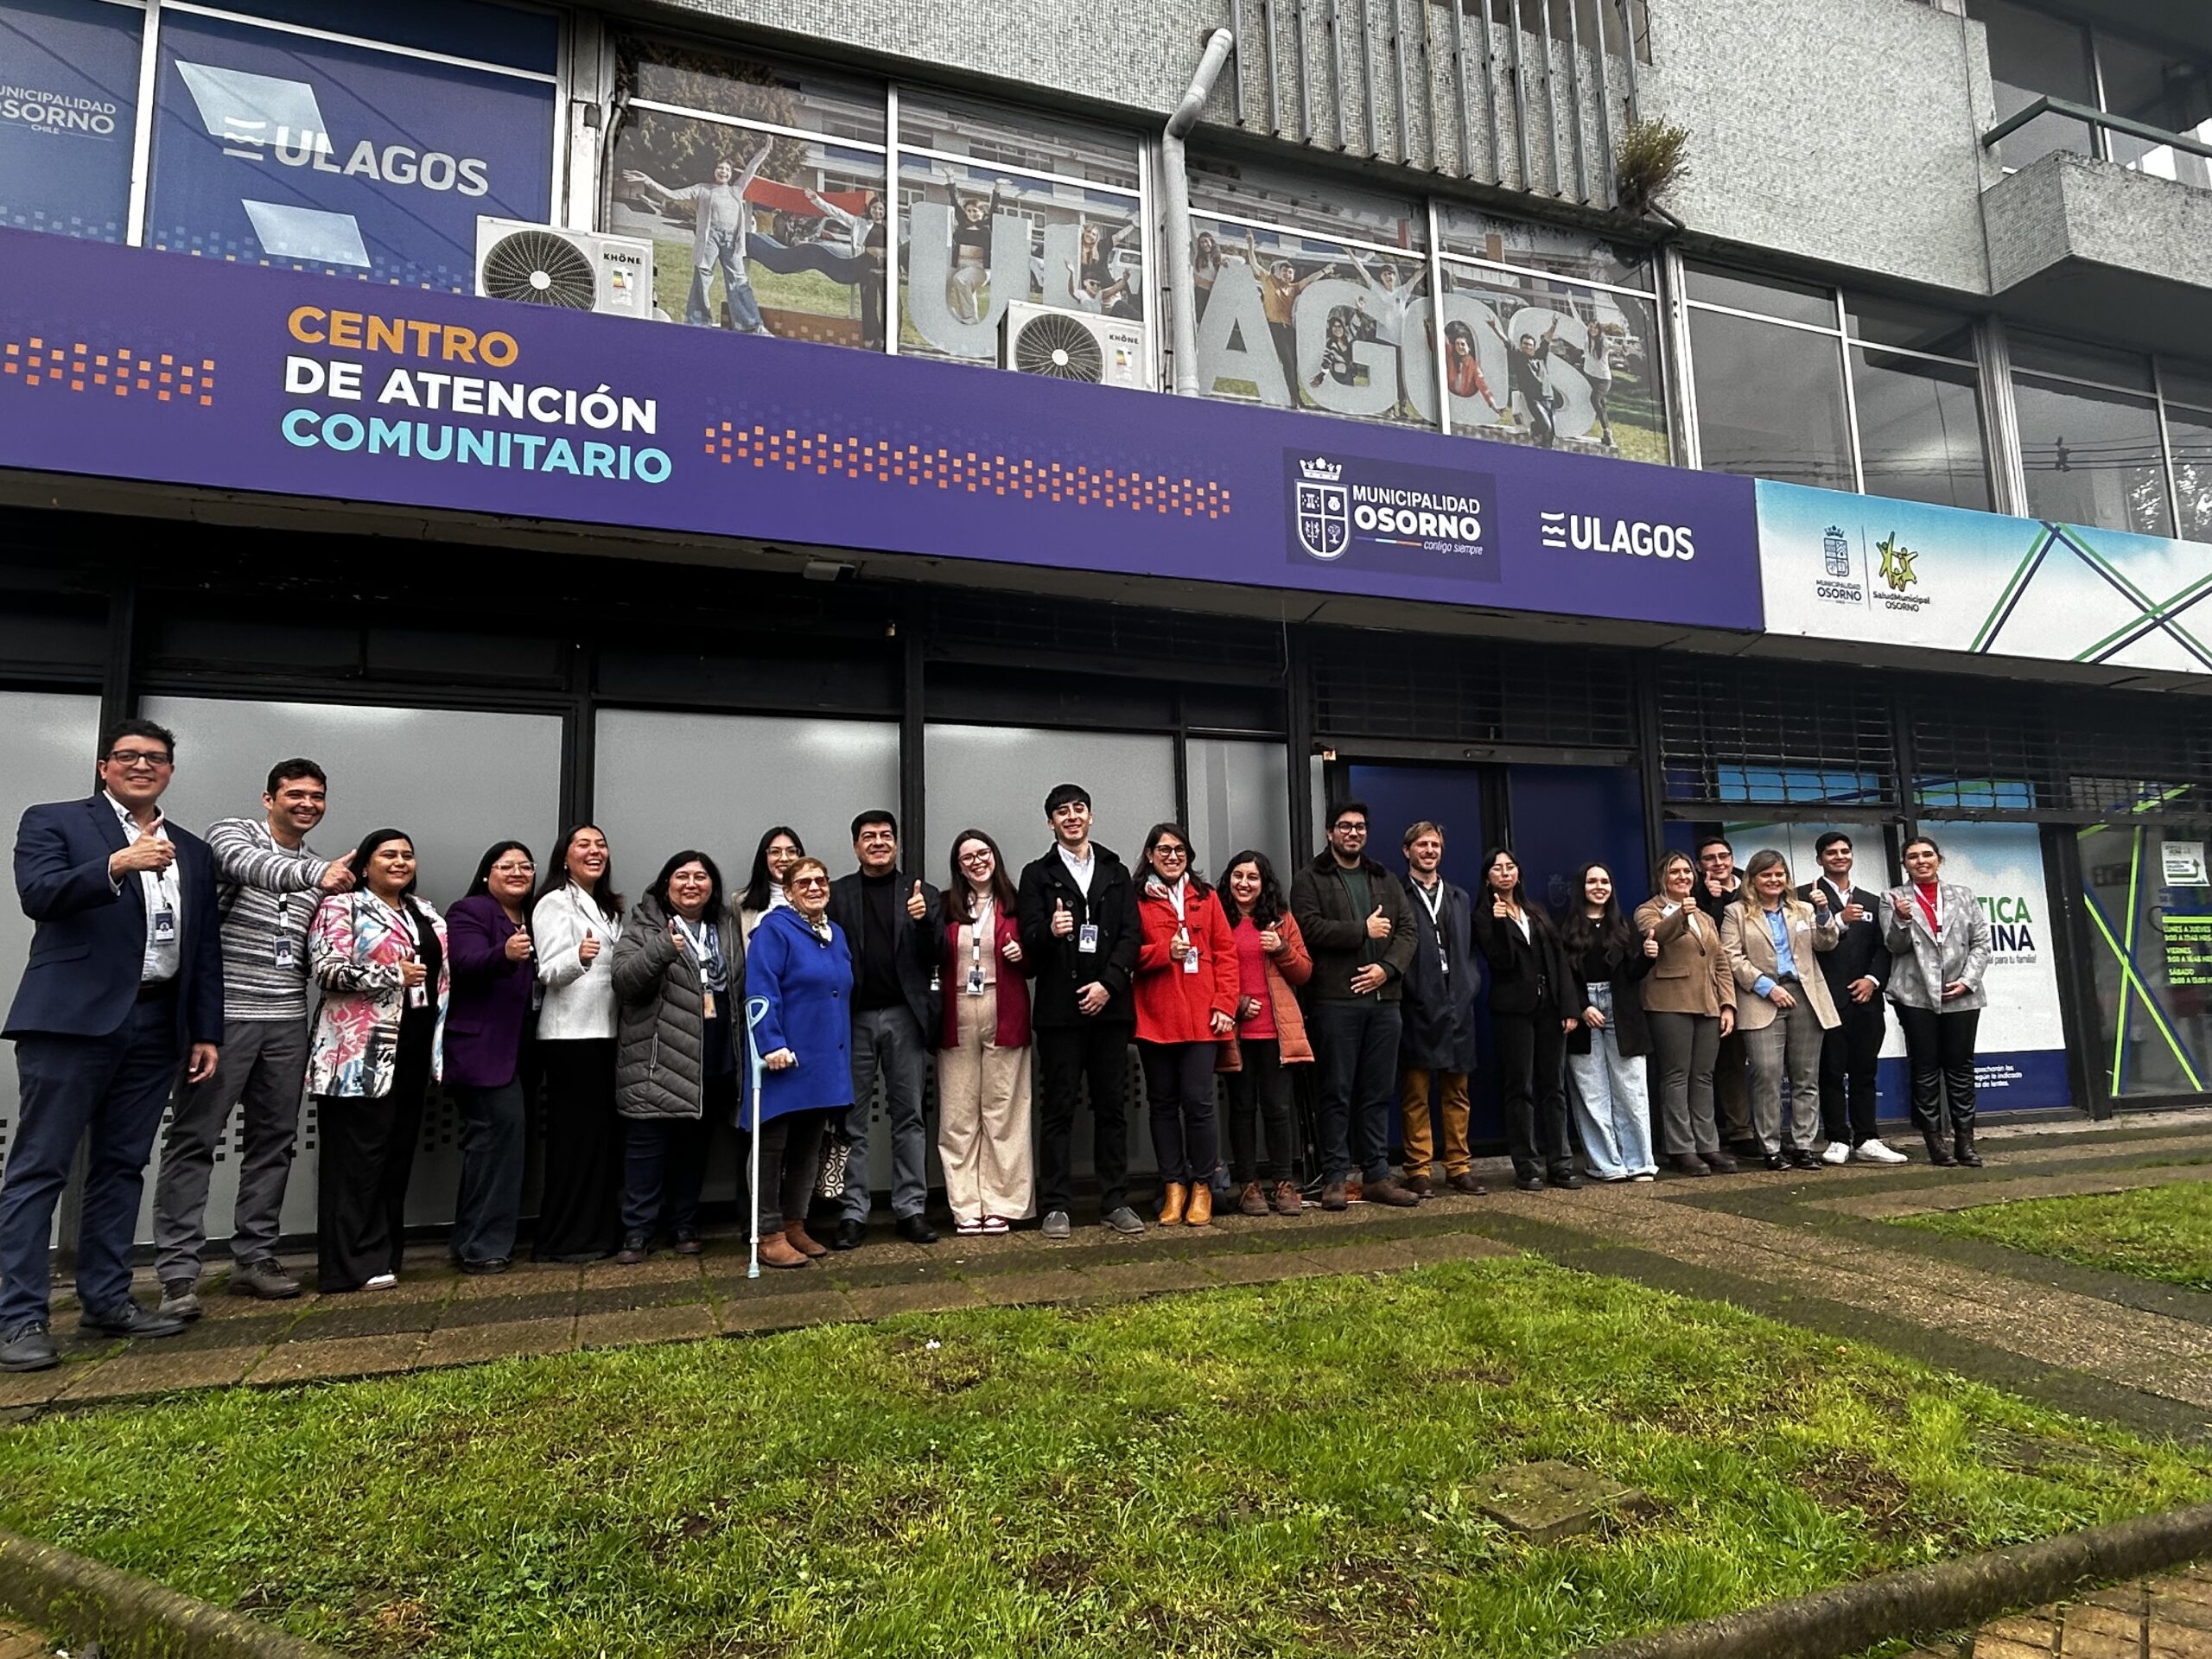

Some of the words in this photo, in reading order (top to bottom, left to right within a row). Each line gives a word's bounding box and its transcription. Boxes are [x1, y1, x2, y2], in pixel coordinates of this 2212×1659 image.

[0, 99, 115, 134] SORNO
[274, 125, 489, 197] ULAGOS
[288, 306, 518, 367] CENTRO
[285, 355, 363, 400] DE
[378, 368, 657, 435] ATENCIÓN
[282, 409, 672, 483] COMUNITARIO
[1352, 485, 1481, 514] MUNICIPALIDAD
[1354, 505, 1482, 541] OSORNO
[1570, 514, 1695, 561] ULAGOS
[1423, 541, 1452, 554] contigo
[1453, 542, 1484, 556] siempre
[1815, 580, 1861, 590] MUNICIPALIDAD
[1817, 587, 1862, 601] OSORNO
[1885, 601, 1919, 612] OSORNO
[1976, 896, 2032, 924] TICA
[1990, 925, 2036, 951] INA
